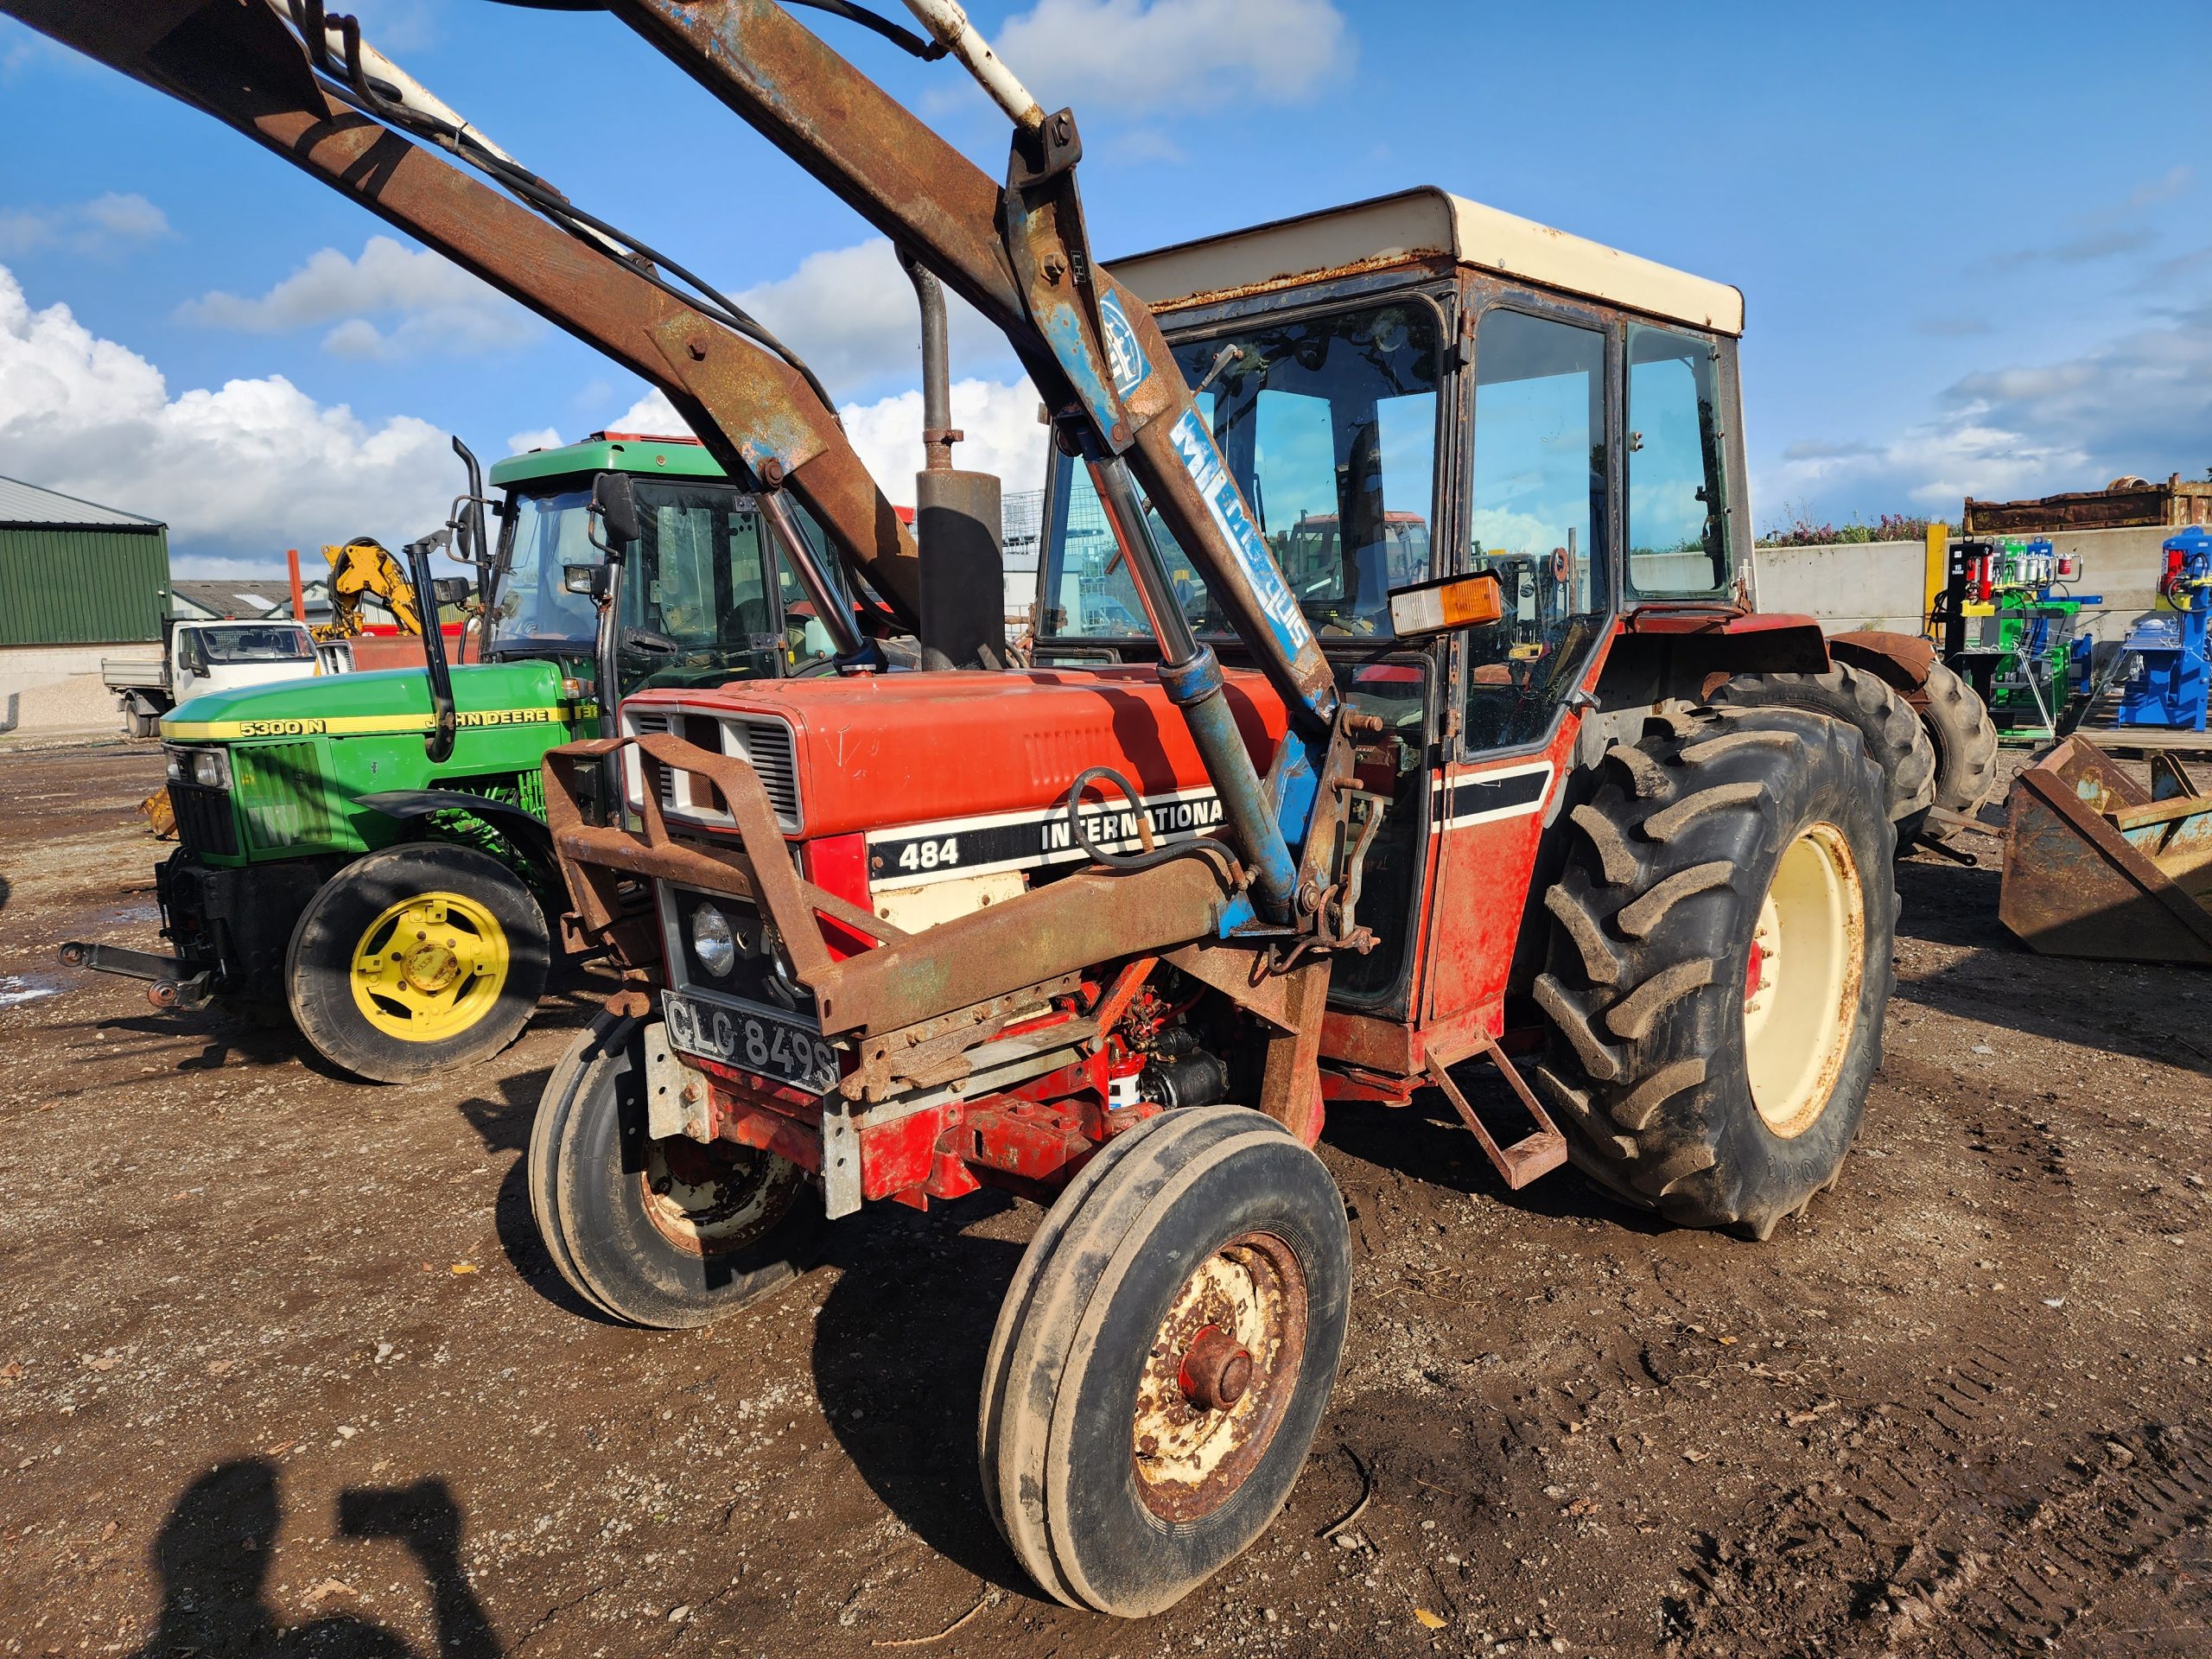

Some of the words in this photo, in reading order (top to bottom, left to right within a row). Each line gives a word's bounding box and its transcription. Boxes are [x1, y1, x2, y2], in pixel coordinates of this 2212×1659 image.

[240, 721, 302, 737] 5300
[308, 719, 326, 734] N
[425, 713, 483, 728] JHN
[486, 709, 549, 724] DEERE
[899, 838, 957, 870] 484
[1041, 799, 1225, 850] INERNTIONA
[668, 1000, 735, 1057] CLG
[745, 1020, 836, 1089] 849S
